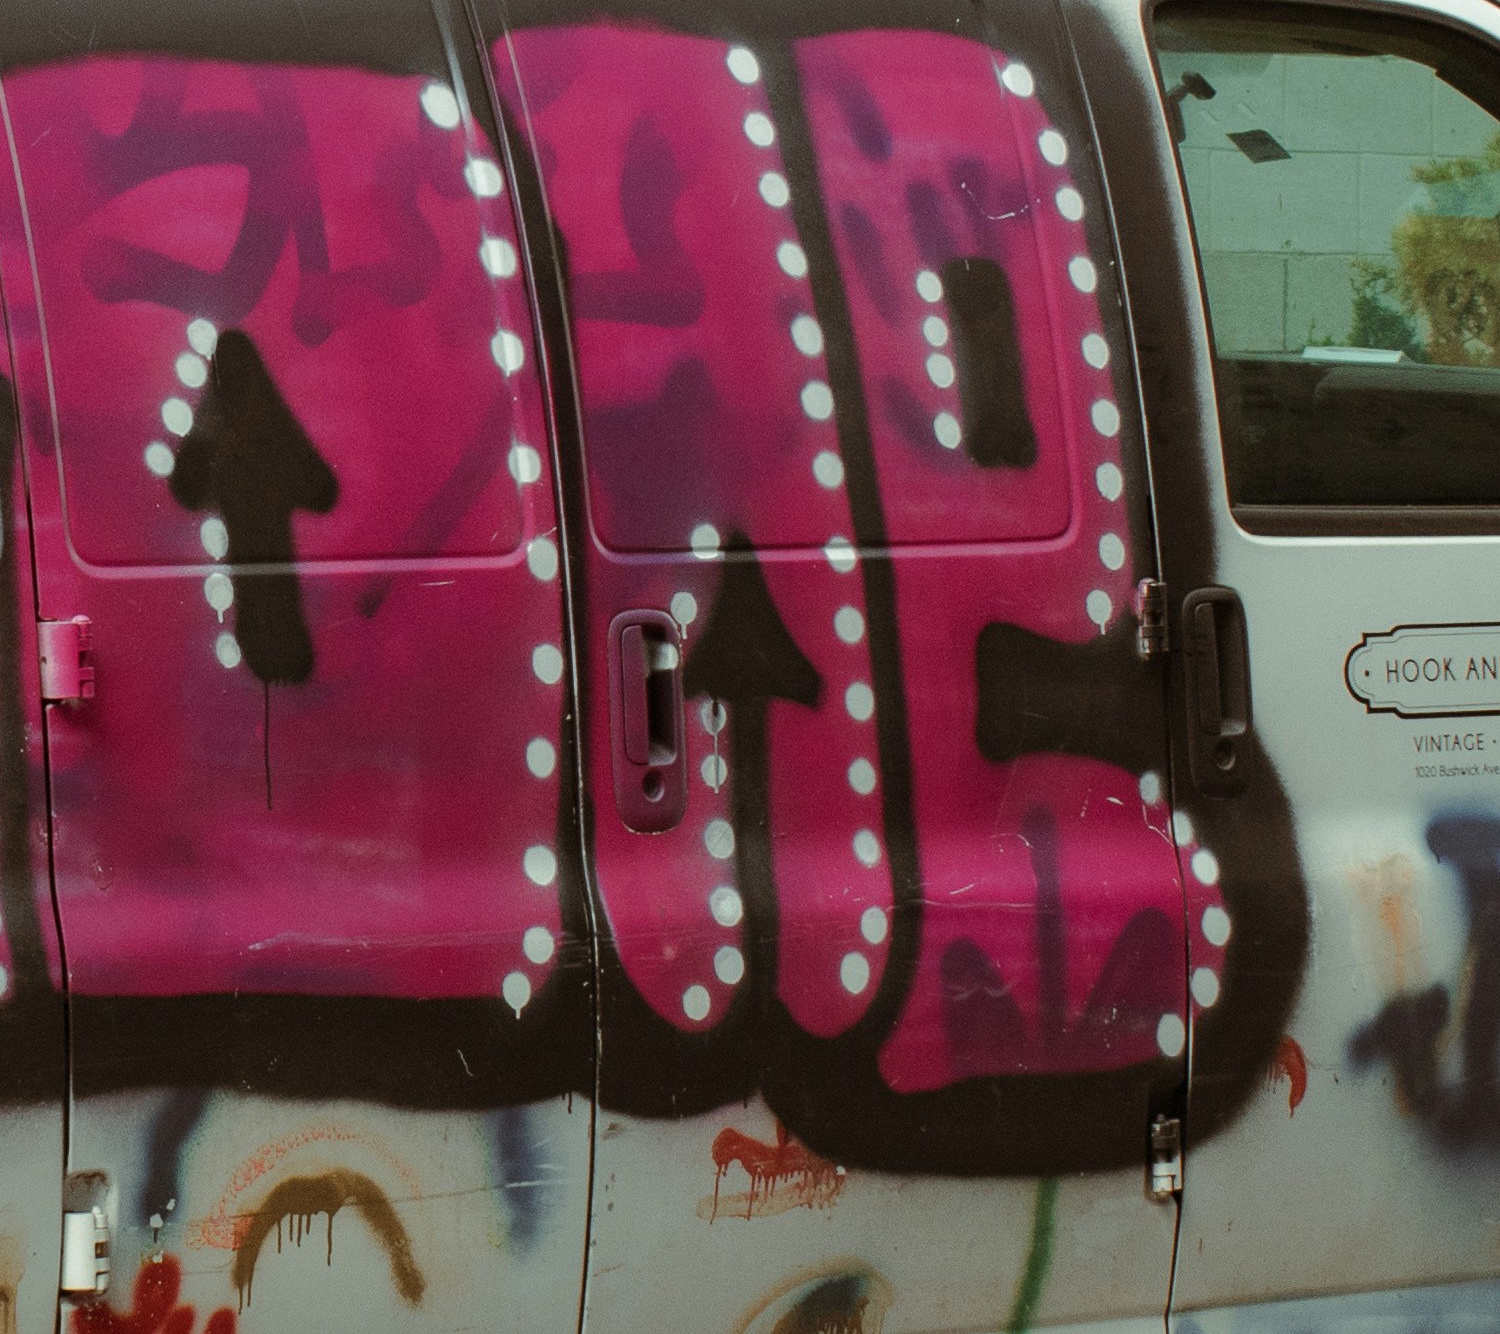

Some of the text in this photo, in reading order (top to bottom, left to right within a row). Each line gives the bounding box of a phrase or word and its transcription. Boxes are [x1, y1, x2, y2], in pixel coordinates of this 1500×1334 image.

[1385, 657, 1457, 683] HOOK
[1413, 732, 1485, 752] VINTAGE
[1414, 766, 1438, 779] 1020
[1438, 764, 1481, 778] Bushwick
